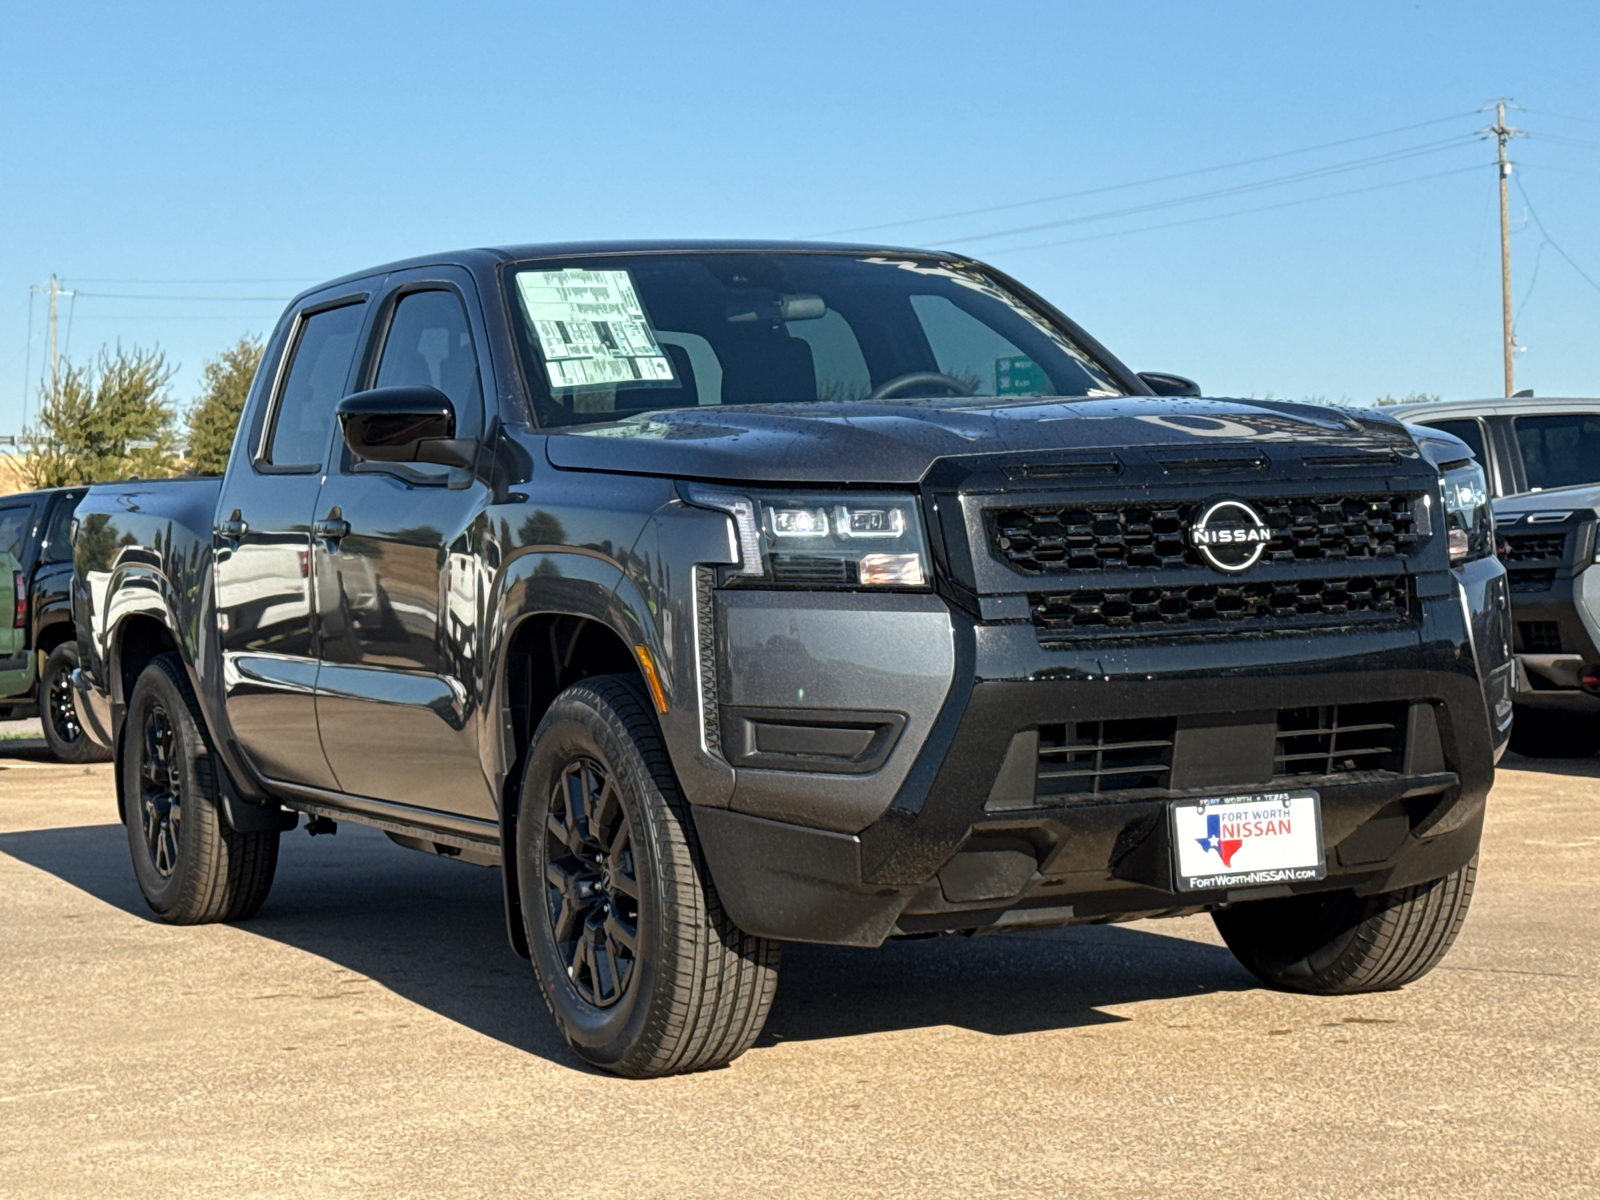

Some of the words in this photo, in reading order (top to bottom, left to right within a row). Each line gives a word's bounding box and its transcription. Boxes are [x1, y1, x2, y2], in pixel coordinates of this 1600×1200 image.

[1194, 528, 1270, 543] NISSAN
[1199, 798, 1220, 806] FORT
[1224, 796, 1252, 804] WORTH
[1264, 793, 1290, 801] TEXAS
[1221, 811, 1249, 822] FORT
[1252, 809, 1291, 820] WORTH
[1222, 819, 1292, 839] NISSAN
